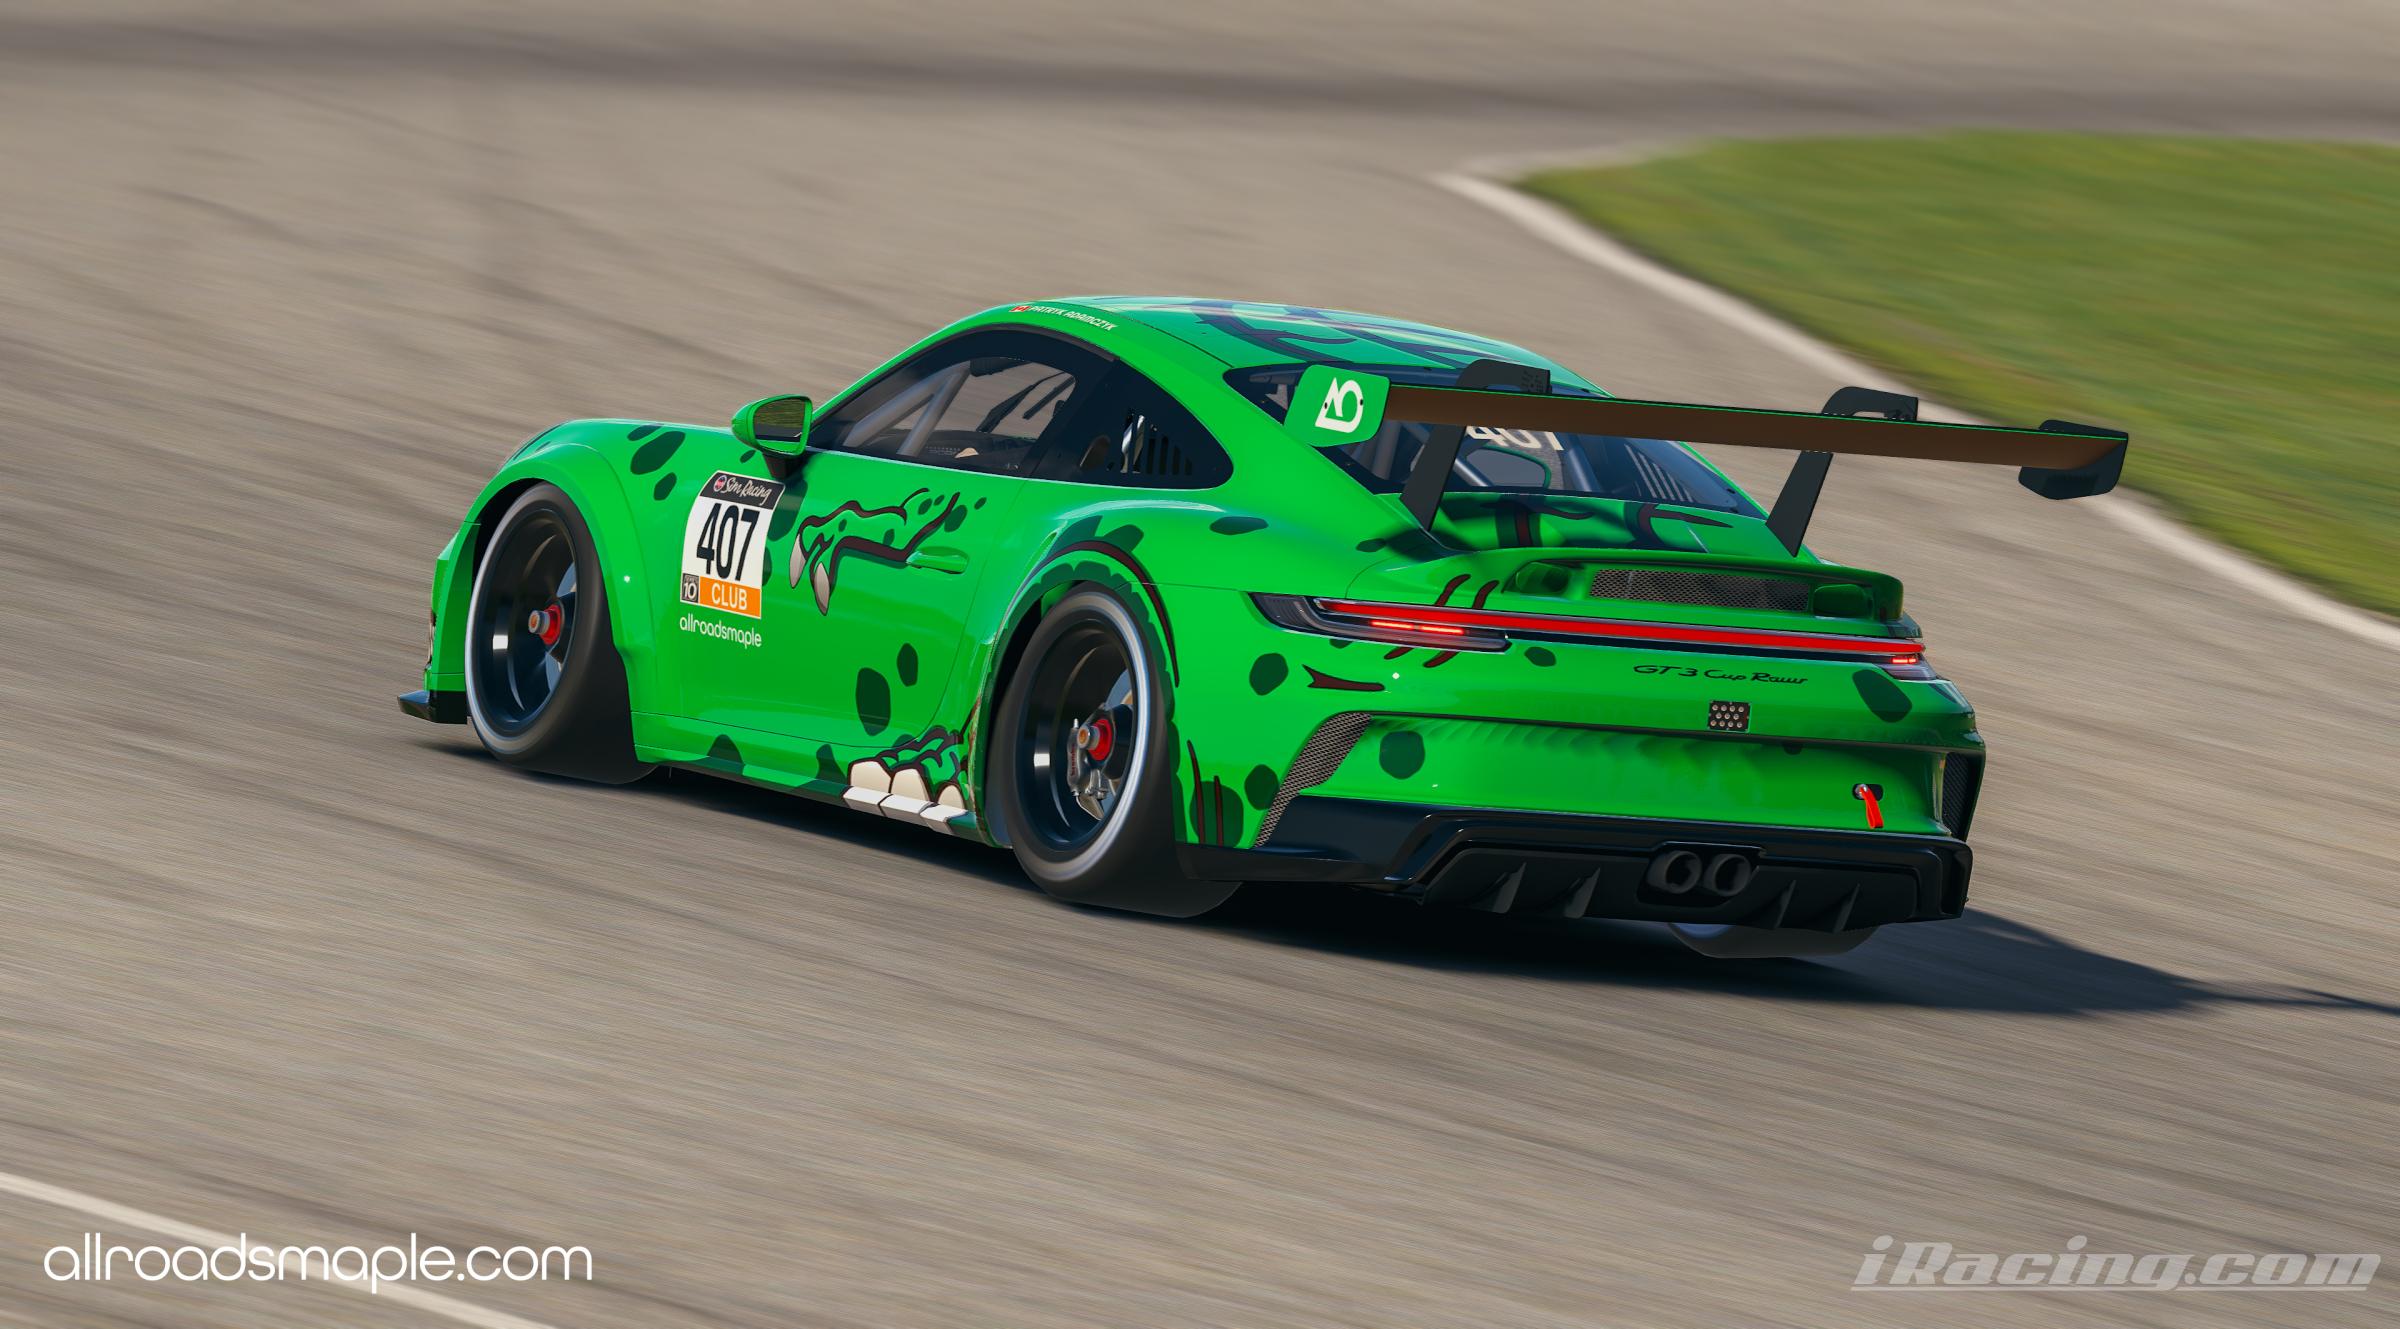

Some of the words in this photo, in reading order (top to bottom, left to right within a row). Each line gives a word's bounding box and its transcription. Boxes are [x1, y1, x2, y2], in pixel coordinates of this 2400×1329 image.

[739, 480, 772, 506] Racing
[696, 502, 760, 582] 407
[683, 583, 697, 599] 10
[711, 582, 748, 611] CLUB
[679, 613, 762, 649] allroadsmaple
[1703, 669, 1747, 682] Cup
